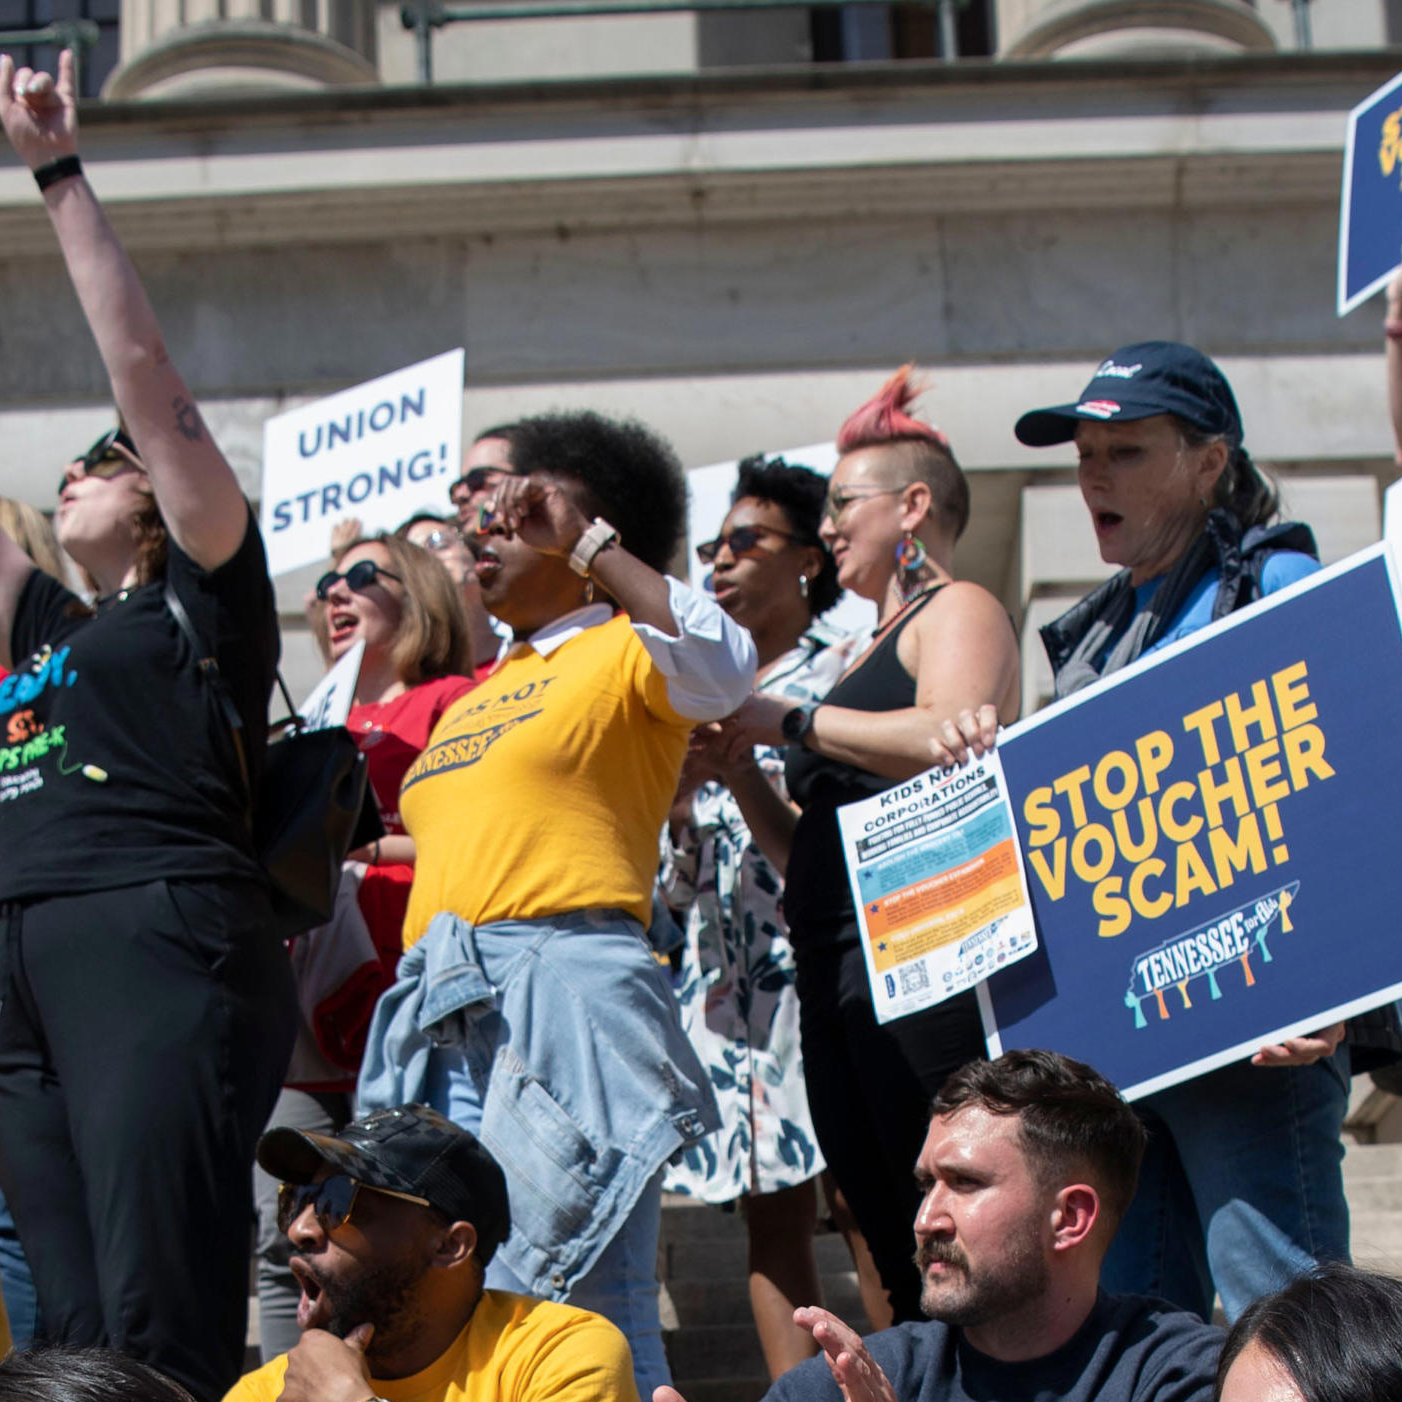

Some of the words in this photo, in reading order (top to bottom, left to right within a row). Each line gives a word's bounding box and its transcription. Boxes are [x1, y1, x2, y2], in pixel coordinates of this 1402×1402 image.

[299, 387, 426, 458] UNION
[273, 443, 447, 532] STRONG!
[863, 765, 986, 832] CORPORATIONS
[880, 780, 923, 808] KIDS
[928, 759, 963, 786] NO
[1023, 730, 1175, 847] STOP
[1182, 660, 1319, 768] THE
[1028, 723, 1336, 902] VOUCHER
[1092, 802, 1290, 938] SCAM!
[1136, 911, 1249, 992] TENNESSEE
[1244, 917, 1259, 933] for
[1255, 898, 1279, 924] ALL
